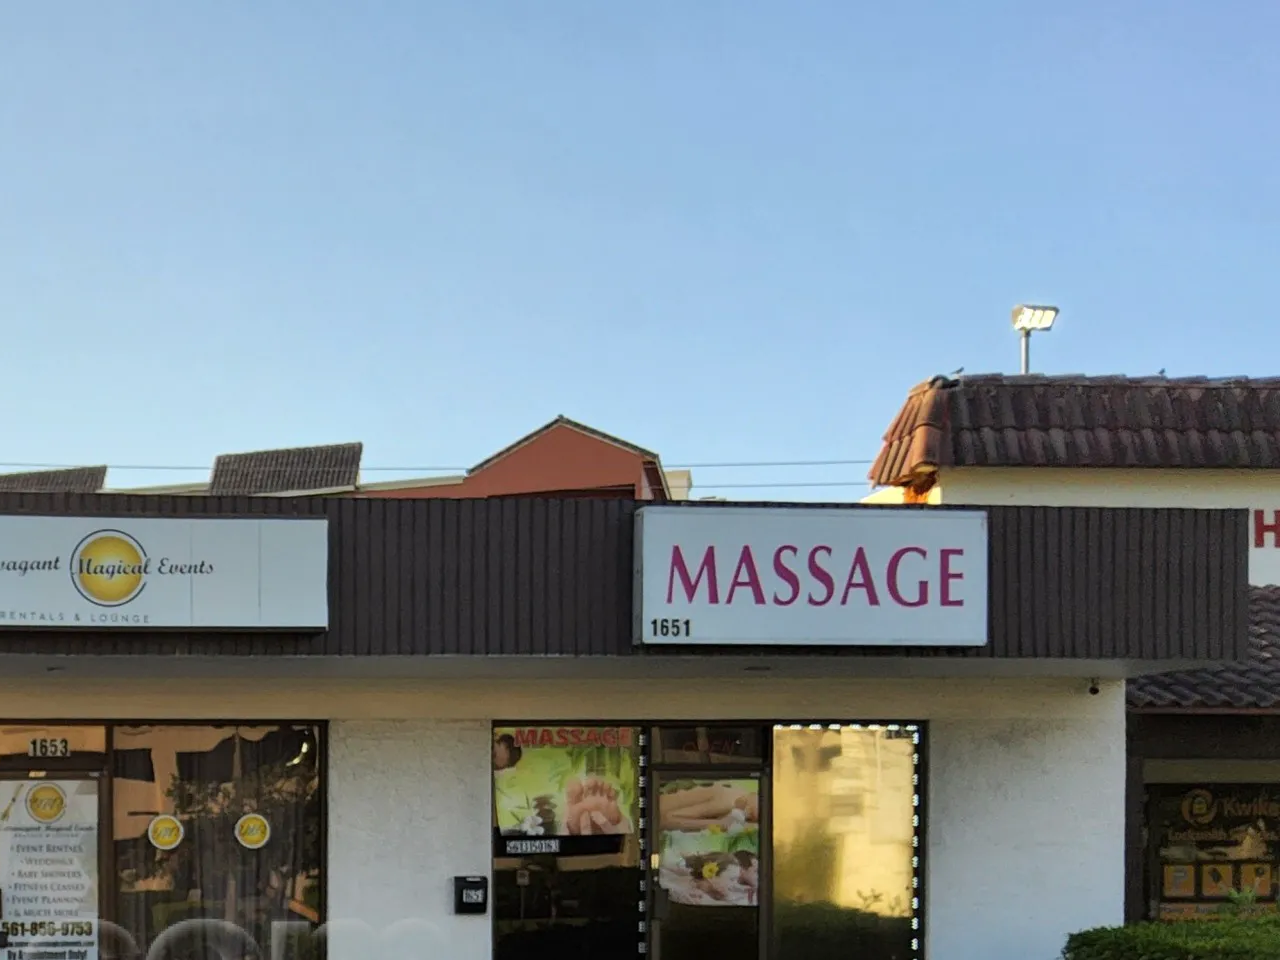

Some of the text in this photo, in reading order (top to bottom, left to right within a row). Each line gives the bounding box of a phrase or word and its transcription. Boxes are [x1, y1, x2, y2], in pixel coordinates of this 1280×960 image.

[70, 556, 152, 581] Magical
[157, 555, 215, 577] Events
[665, 544, 965, 608] MASSAGE
[0, 610, 151, 624] RENTALS & LOUNGE
[651, 618, 692, 638] 1651
[30, 738, 69, 756] 1653
[514, 727, 634, 747] MASSAGE
